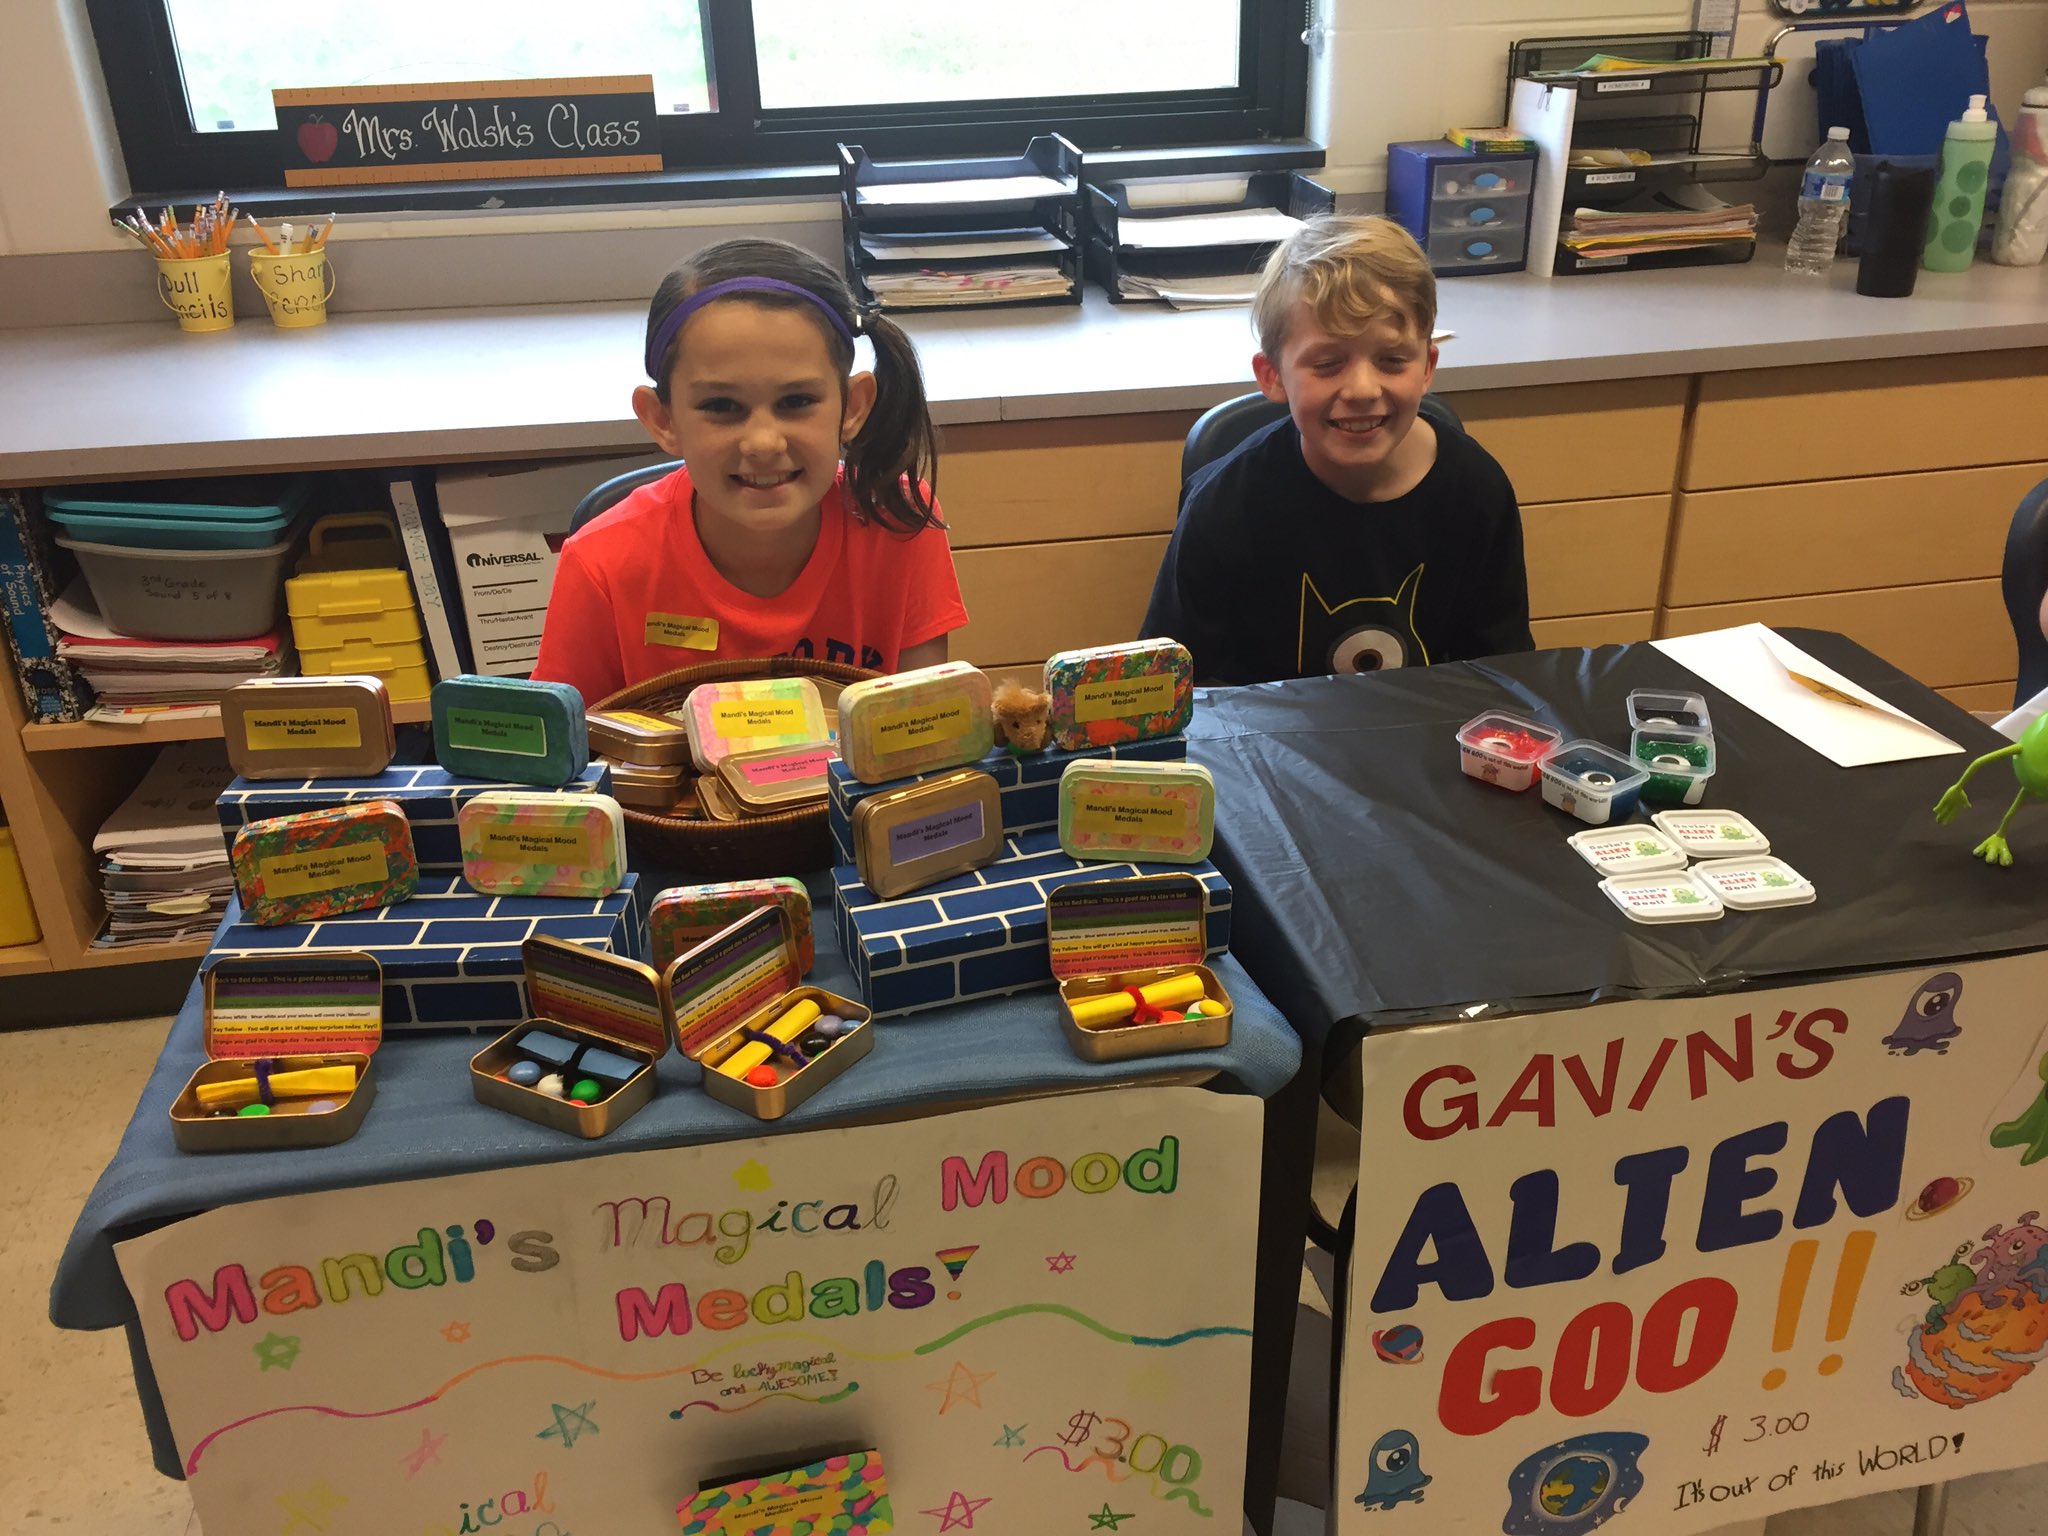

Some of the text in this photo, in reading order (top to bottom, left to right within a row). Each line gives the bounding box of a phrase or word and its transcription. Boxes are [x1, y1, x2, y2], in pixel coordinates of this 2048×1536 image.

[343, 103, 640, 160] Mrs. Walsh's Class
[160, 271, 199, 294] Dull
[0, 563, 25, 616] of Sound
[13, 564, 33, 607] Physics
[1085, 684, 1164, 701] Mandi's Magical Mood
[1111, 697, 1138, 706] Medals
[721, 708, 794, 719] Mandi's Magical Mood
[254, 717, 347, 728] Mandi's Magical Mood
[454, 717, 535, 732] Mandi's Magical Mood
[747, 717, 771, 725] Medals
[880, 709, 960, 733] Mandi's Magical Mood
[287, 727, 317, 736] Medals
[481, 729, 508, 738] Medals
[908, 724, 934, 736] Medals
[1086, 804, 1173, 816] Mandi's Magical Mood
[1114, 814, 1143, 823] Medals
[896, 813, 973, 841] Mandi's Magical Mood
[1679, 828, 1715, 836] ALIEN
[490, 833, 577, 846] Mandi's Magical Mood
[924, 830, 948, 842] Medals
[519, 843, 549, 852] Medals
[1595, 846, 1631, 856] ALIEN
[273, 854, 372, 875] Mandi's Magical Mood
[308, 867, 341, 880] Medals
[1718, 877, 1757, 886] ALIEN
[1628, 893, 1667, 901] ALIEN
[1402, 1006, 1850, 1142] GAVIN'S
[1370, 1095, 1911, 1315] ALIEN
[164, 1135, 1179, 1343] Mandi's Magical Mood
[616, 1244, 979, 1342] Medals!
[691, 1368, 724, 1385] Be
[720, 1384, 746, 1397] and
[1702, 1412, 1810, 1457] $ 3.00
[1057, 1409, 1201, 1485] $3.00
[1709, 1476, 1759, 1502] out
[1768, 1465, 1798, 1491] of
[1813, 1460, 1845, 1481] this
[1858, 1432, 1965, 1476] WORLD!
[459, 1471, 556, 1535] ical
[734, 1496, 822, 1519] Mandi's Magical Mood
[764, 1507, 793, 1517] Medals
